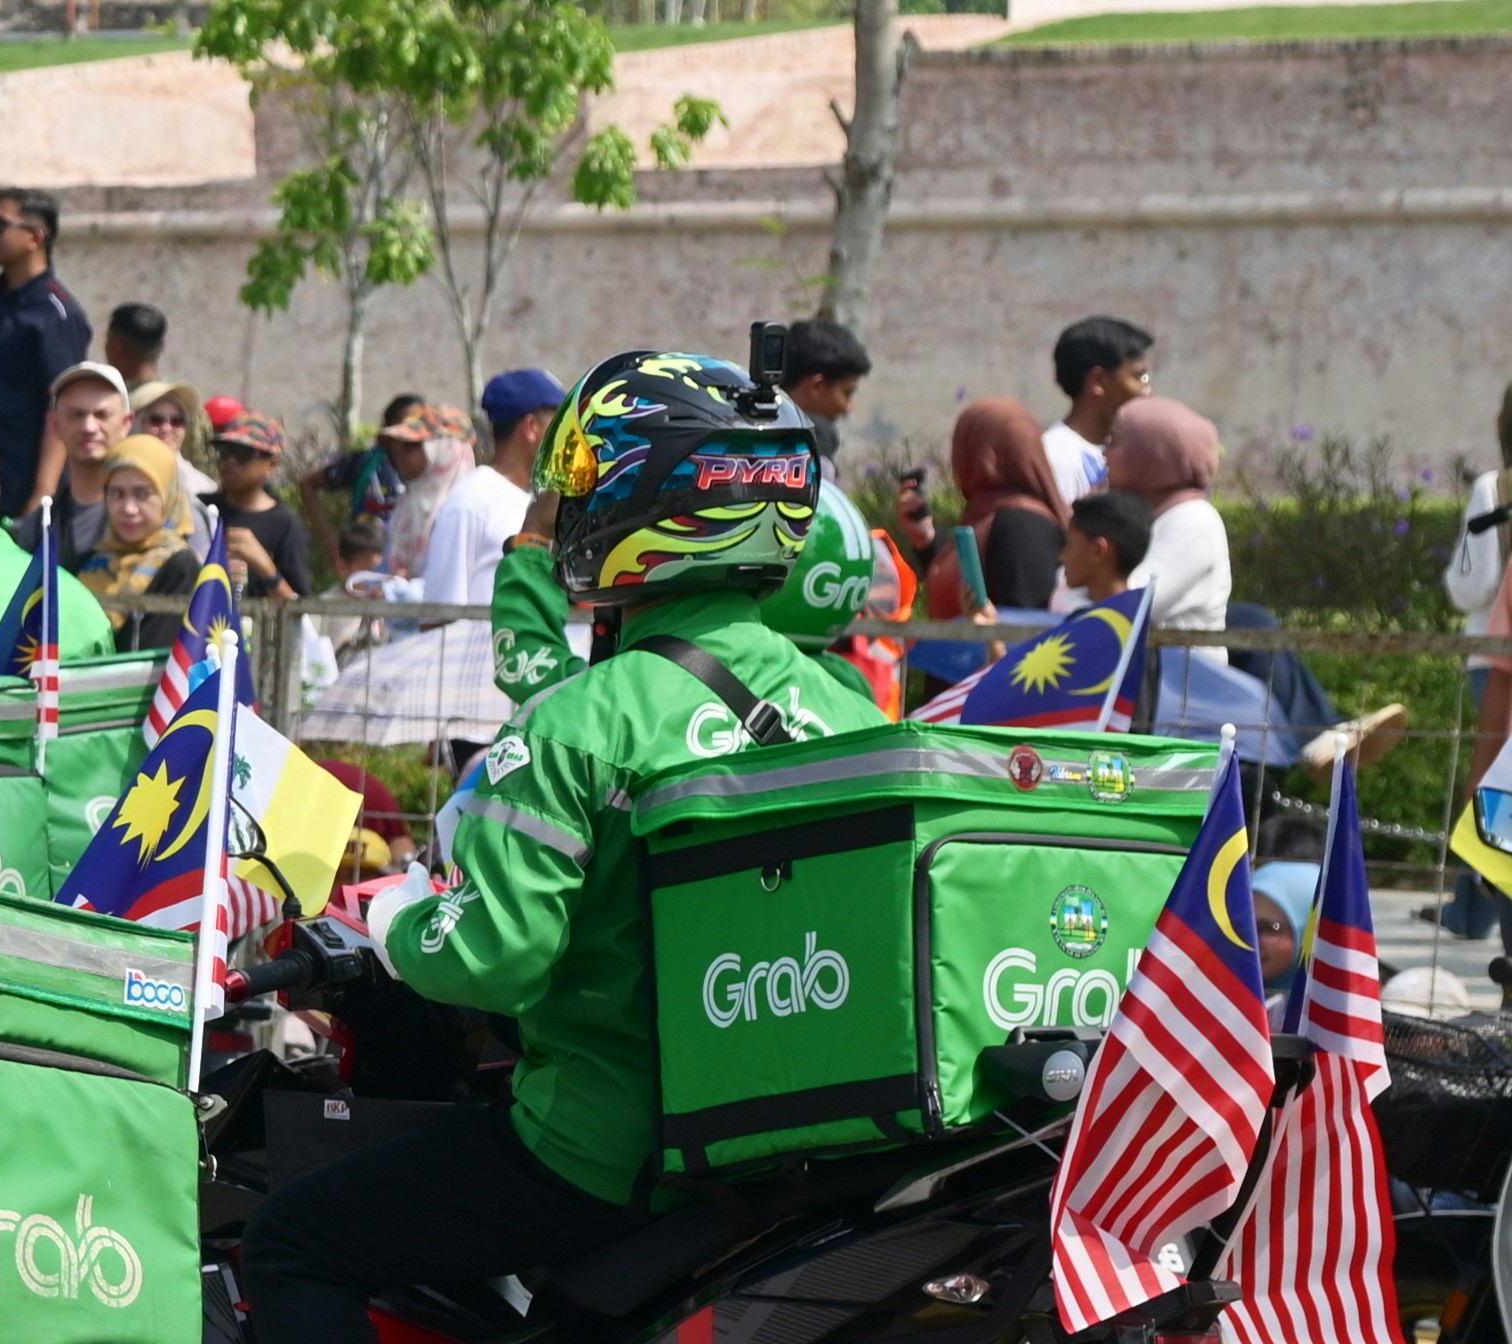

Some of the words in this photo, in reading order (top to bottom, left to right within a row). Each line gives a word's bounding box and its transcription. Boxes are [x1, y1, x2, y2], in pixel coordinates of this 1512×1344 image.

[695, 455, 811, 492] PYRO
[803, 562, 871, 612] Gra
[701, 929, 851, 1030] Grab
[982, 947, 1144, 1032] Gra
[1045, 1068, 1079, 1084] GIVI
